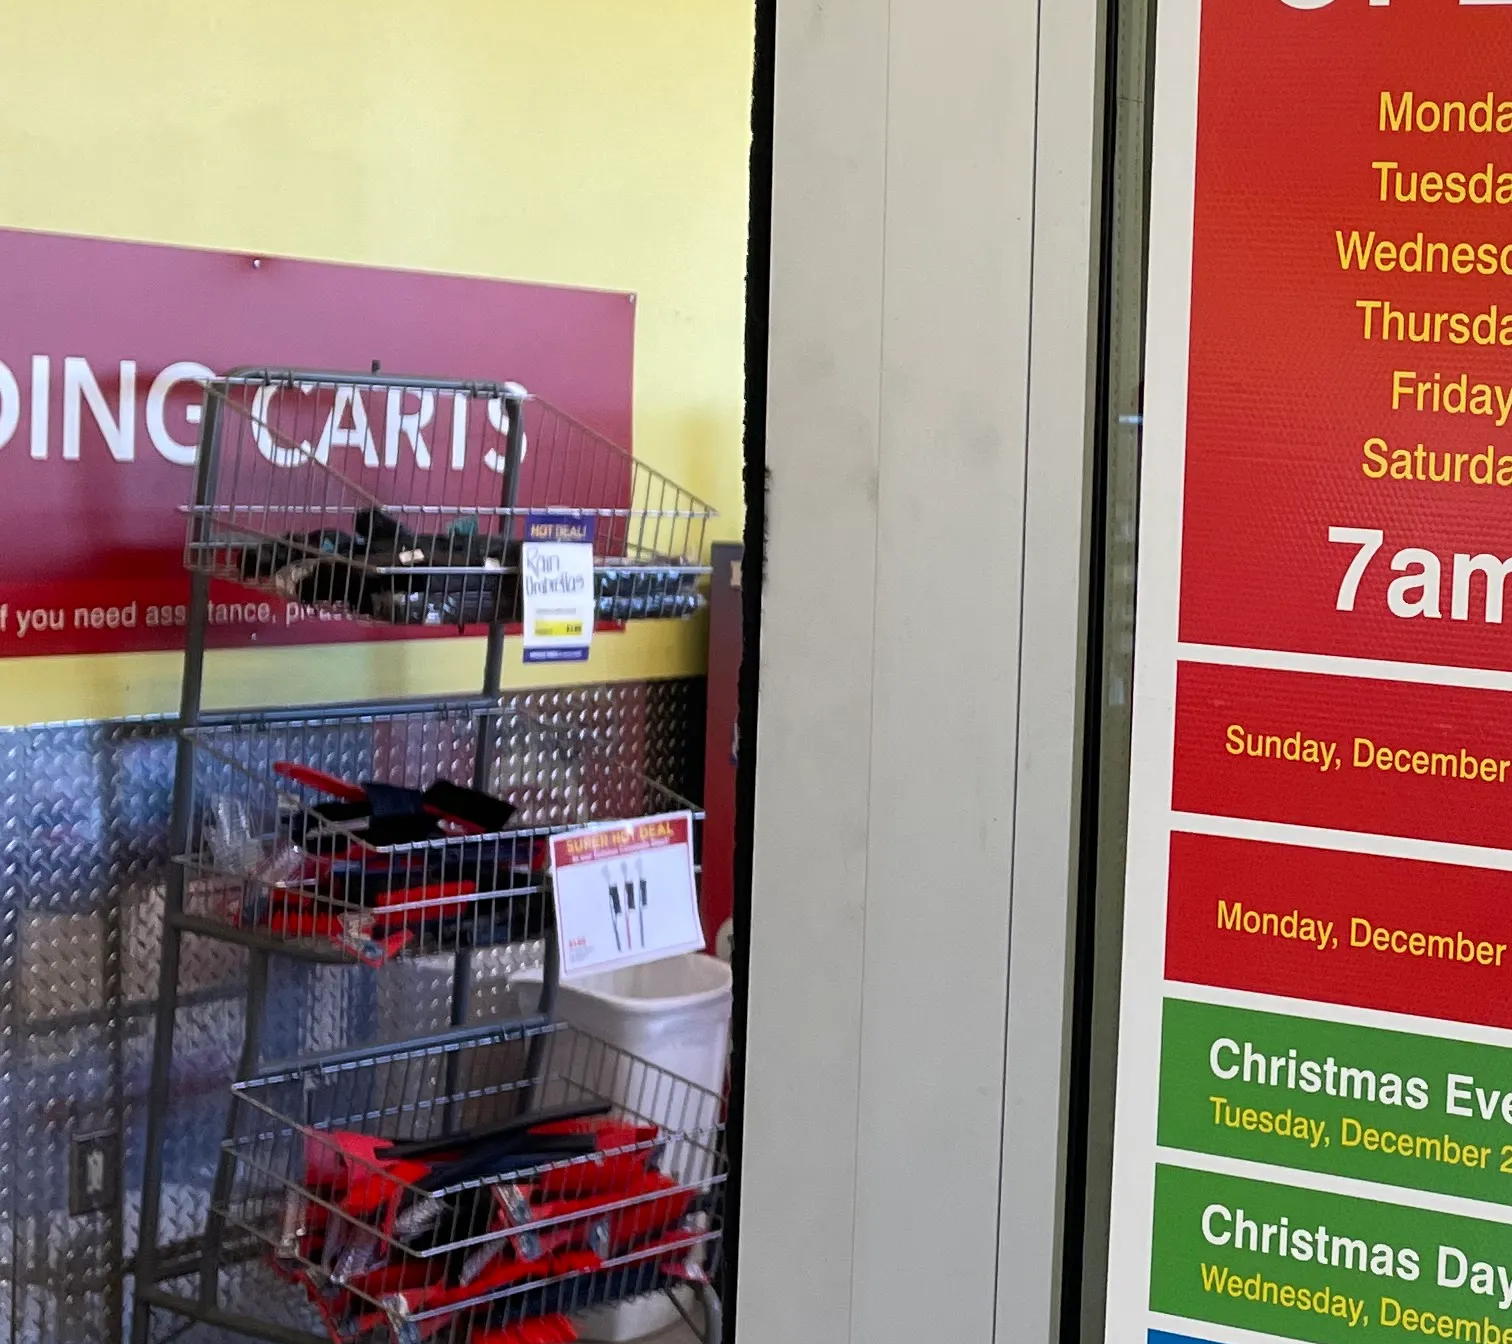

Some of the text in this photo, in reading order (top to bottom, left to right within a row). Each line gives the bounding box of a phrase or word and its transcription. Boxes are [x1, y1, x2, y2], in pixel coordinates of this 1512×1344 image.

[531, 524, 553, 538] HOT
[526, 547, 560, 578] Rain
[16, 607, 65, 638] you
[74, 601, 138, 628] need
[145, 601, 277, 627] asstance,
[1226, 725, 1340, 771] Sunday,
[1354, 738, 1510, 782] December
[566, 834, 608, 854] SUPER
[639, 820, 675, 840] DEAL
[1218, 901, 1337, 950] Monday,
[1351, 918, 1506, 965] December
[1210, 1038, 1428, 1112] Christmas
[1210, 1097, 1329, 1148] Tuesday,
[1342, 1120, 1491, 1168] December
[1201, 1205, 1419, 1283] Christmas
[1201, 1263, 1368, 1326] Wednesday,
